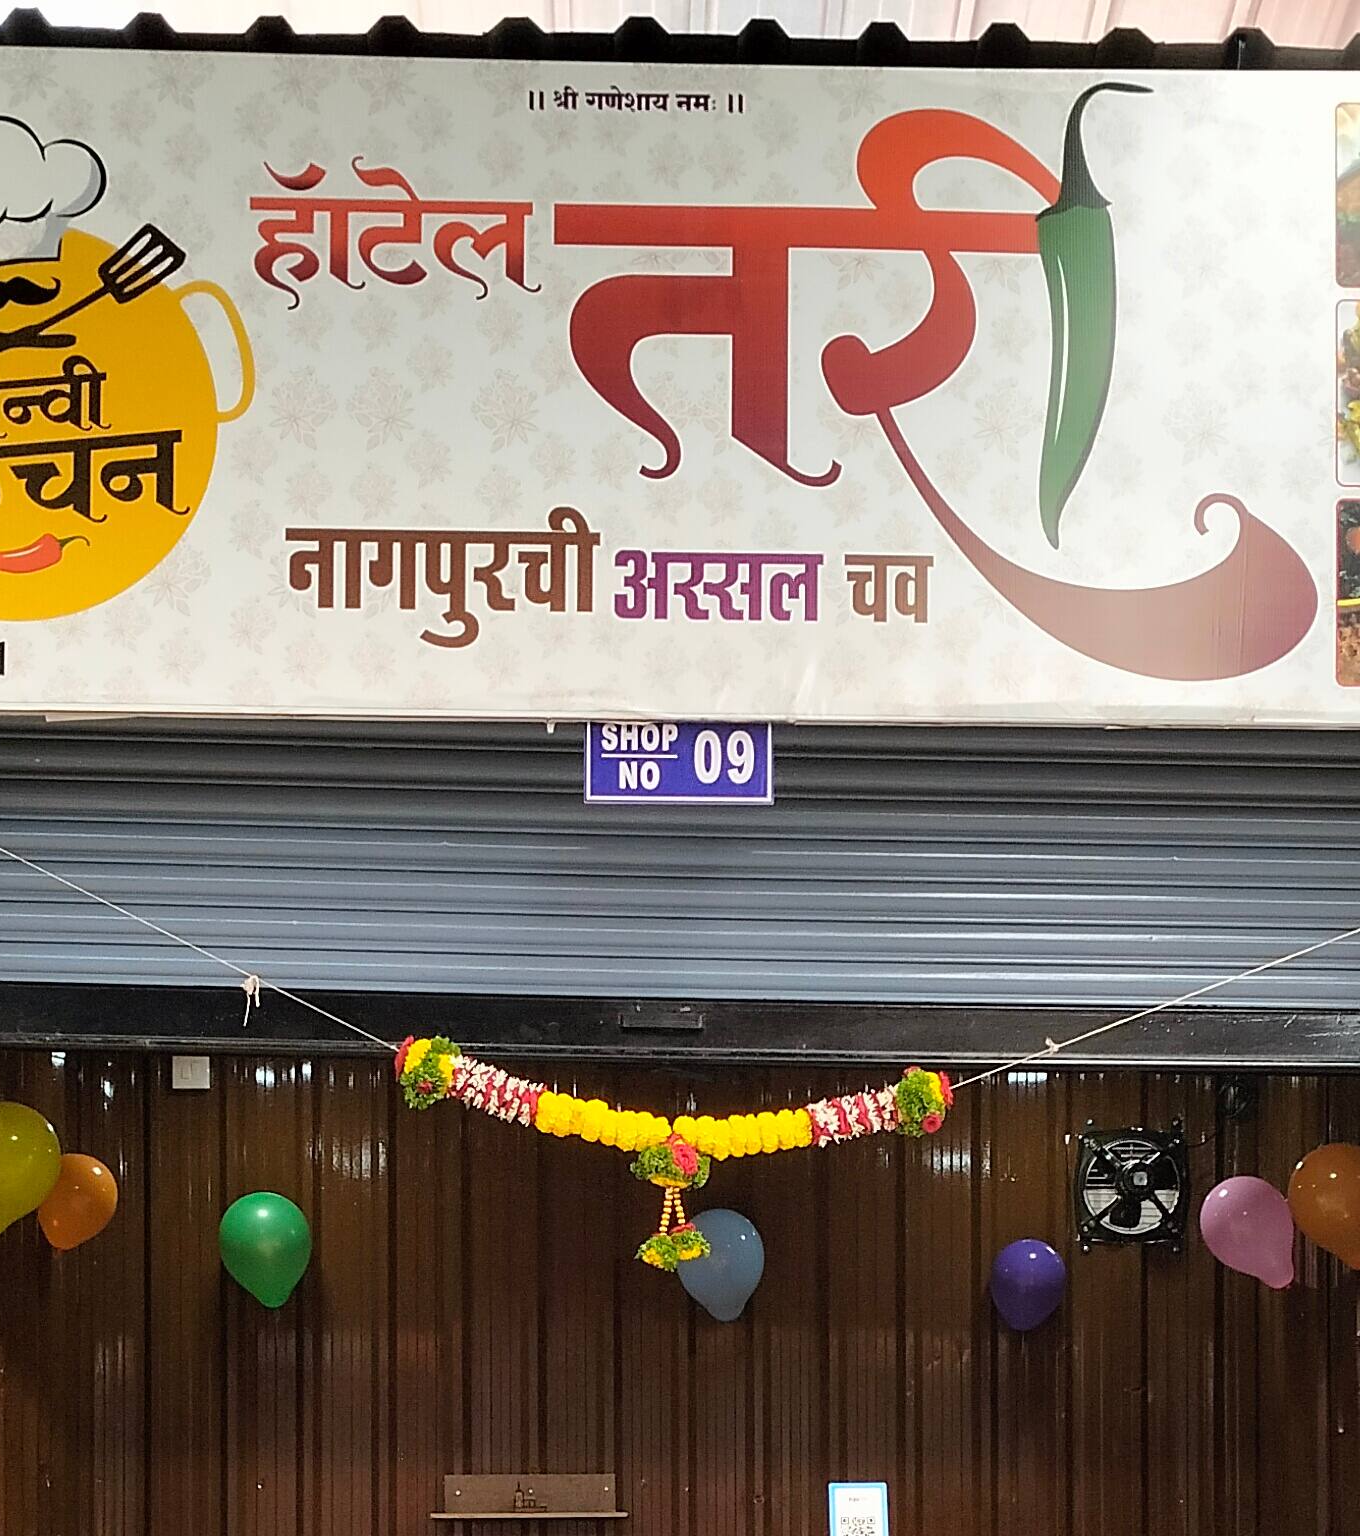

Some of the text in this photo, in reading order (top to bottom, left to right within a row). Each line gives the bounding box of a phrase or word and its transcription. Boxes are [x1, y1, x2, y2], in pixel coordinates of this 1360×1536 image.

[554, 86, 579, 110] श्री
[585, 85, 669, 112] गणेशाय
[675, 93, 716, 111] नमः
[250, 156, 542, 310] हॉटेल
[286, 506, 934, 648] नागपुरची अस्सल चव
[601, 723, 679, 751] SHOP
[693, 730, 755, 784] 09
[619, 761, 660, 790] NO
